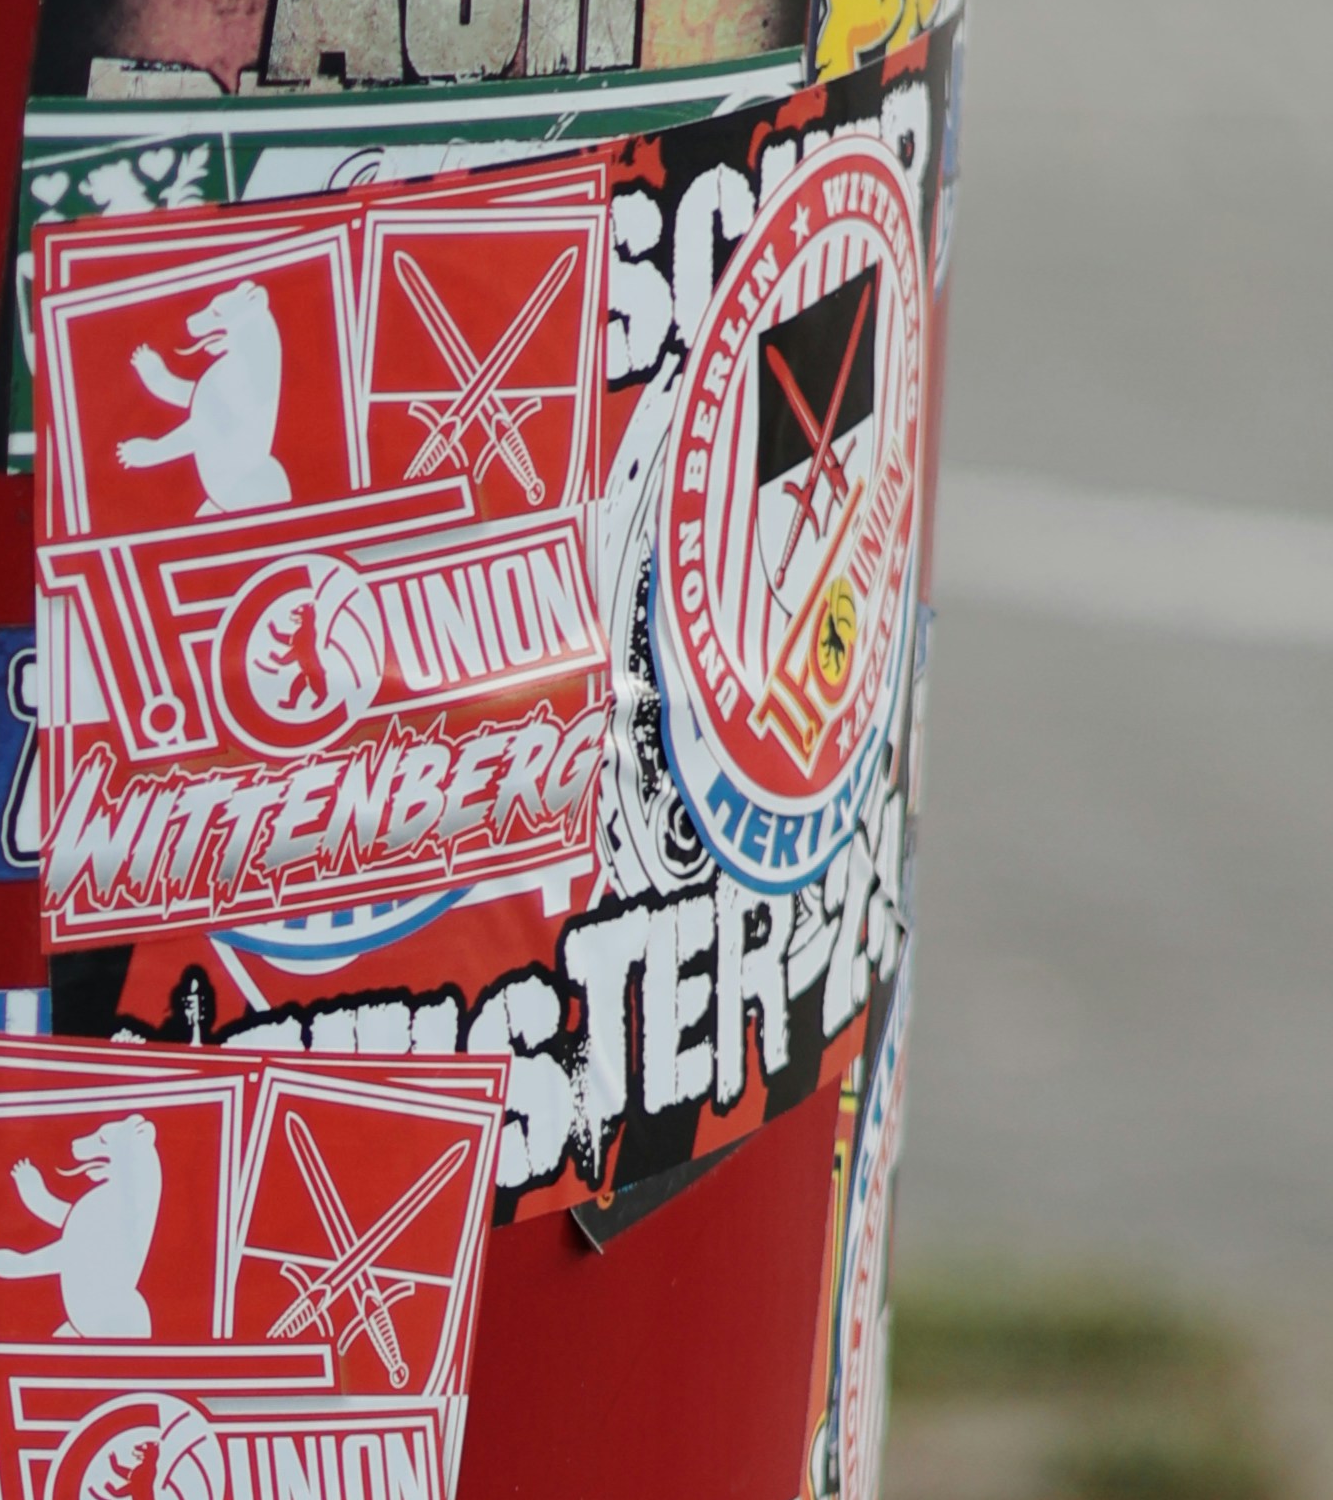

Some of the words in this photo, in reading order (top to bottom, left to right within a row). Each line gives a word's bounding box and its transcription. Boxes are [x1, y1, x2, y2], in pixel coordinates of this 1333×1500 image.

[682, 245, 782, 495] BERLIN
[380, 542, 590, 694] UNION
[678, 518, 743, 722] UNION
[42, 703, 613, 910] WITTENBERG
